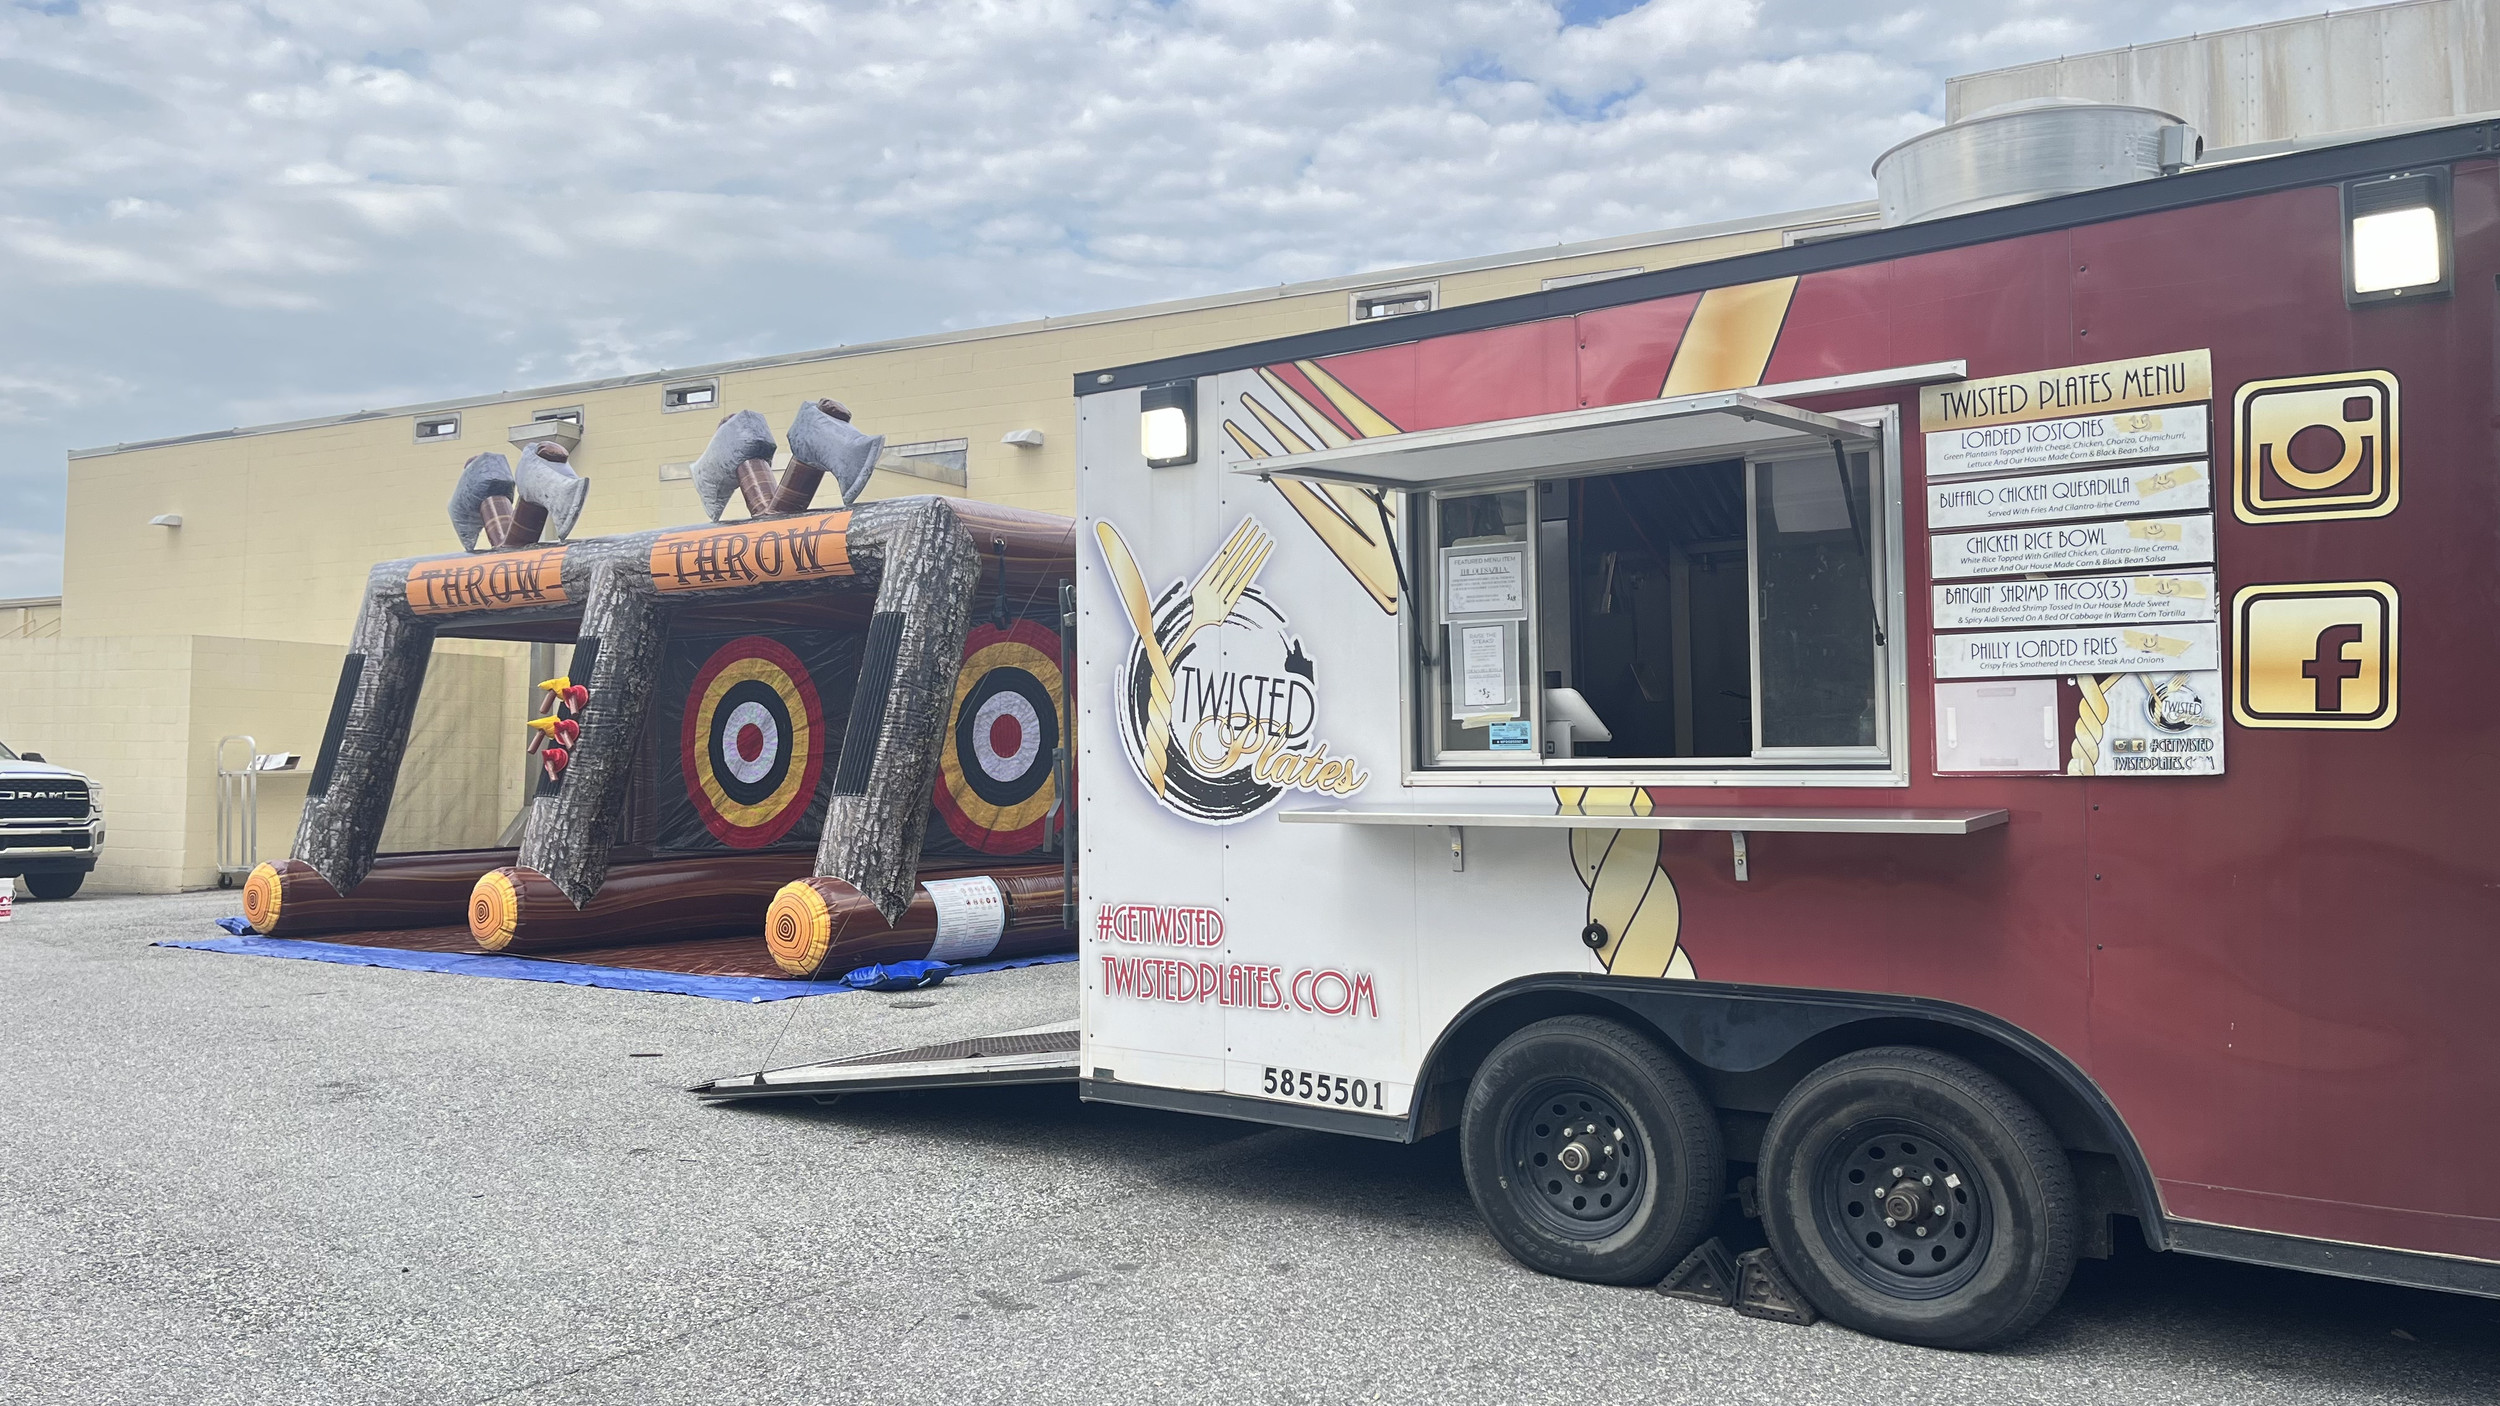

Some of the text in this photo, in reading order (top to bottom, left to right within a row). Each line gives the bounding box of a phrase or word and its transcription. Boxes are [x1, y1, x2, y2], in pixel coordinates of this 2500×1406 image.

[1940, 362, 2185, 421] TWISTED PLATES MENU
[1961, 419, 2104, 449] LOADED TOSTONES
[1965, 450, 1998, 459] Plantains
[1999, 447, 2025, 456] Topped
[2027, 445, 2043, 453] With
[2073, 440, 2104, 449] Chicken,
[2106, 437, 2137, 446] Chorizo,
[2138, 432, 2187, 442] Chimichurri,
[1967, 460, 1992, 468] Lettuce
[1993, 458, 2008, 466] And
[2024, 456, 2046, 464] House
[2048, 453, 2069, 461] Made
[2088, 450, 2095, 458] &
[2096, 448, 2117, 456] Black
[2118, 447, 2137, 455] Bean
[2140, 445, 2160, 453] Salsa
[1940, 476, 2130, 508] BUFFALO CHICKEN QUESADILLA
[1988, 509, 2012, 518] Served
[2030, 506, 2048, 514] Fries
[2048, 504, 2064, 512] And
[2064, 500, 2114, 512] Cilantro-lime
[2114, 500, 2140, 508] Crema
[669, 514, 835, 585] THROW
[1966, 528, 2107, 554] CHICKEN RICE BOWL
[1454, 558, 1483, 566] FEATURED
[1484, 556, 1501, 564] MENU
[1973, 566, 1998, 574] Lettuce
[1999, 564, 2014, 572] And
[2030, 562, 2052, 570] House
[2054, 560, 2074, 568] Made
[2094, 558, 2101, 566] &
[2102, 556, 2122, 565] Black
[2146, 554, 2166, 562] Salsa
[1982, 555, 1996, 564] Rice
[1998, 553, 2023, 562] Topped
[2025, 552, 2042, 560] With
[2043, 550, 2067, 558] Grilled
[2068, 549, 2099, 558] Chicken,
[2100, 546, 2150, 556] Cilantro-lime
[2152, 544, 2180, 552] Crema,
[421, 549, 556, 610] THROW
[1946, 579, 2128, 604] BANGIN' SHRIMP TACOS(3)
[1964, 616, 1982, 624] Spicy
[2001, 614, 2024, 622] Served
[2044, 613, 2058, 621] Bed
[2060, 612, 2069, 620] Of
[2070, 611, 2103, 621] Cabbage
[1972, 606, 1990, 614] Hand
[1992, 605, 2020, 613] Breaded
[2022, 604, 2048, 612] Shrimp
[2082, 602, 2098, 610] Our
[2098, 601, 2122, 609] House
[2124, 600, 2146, 608] Made
[1972, 642, 2010, 660] PHILLY
[2016, 639, 2078, 658] LOADED
[2084, 636, 2118, 656] FRIES
[1980, 662, 2000, 670] Crispy
[2020, 660, 2058, 668] Smothered
[2068, 658, 2096, 666] Cheese,
[2136, 656, 2165, 664] Onions
[1181, 665, 1316, 739] TWISTED
[2164, 700, 2202, 716] TWISTED
[1189, 712, 1368, 795] Plates
[18, 791, 63, 799] RAM
[1097, 904, 1224, 946] #GETTWISTED
[1101, 956, 1378, 1018] TWISTEDPLATES.COM
[1263, 1067, 1384, 1111] 5855501
